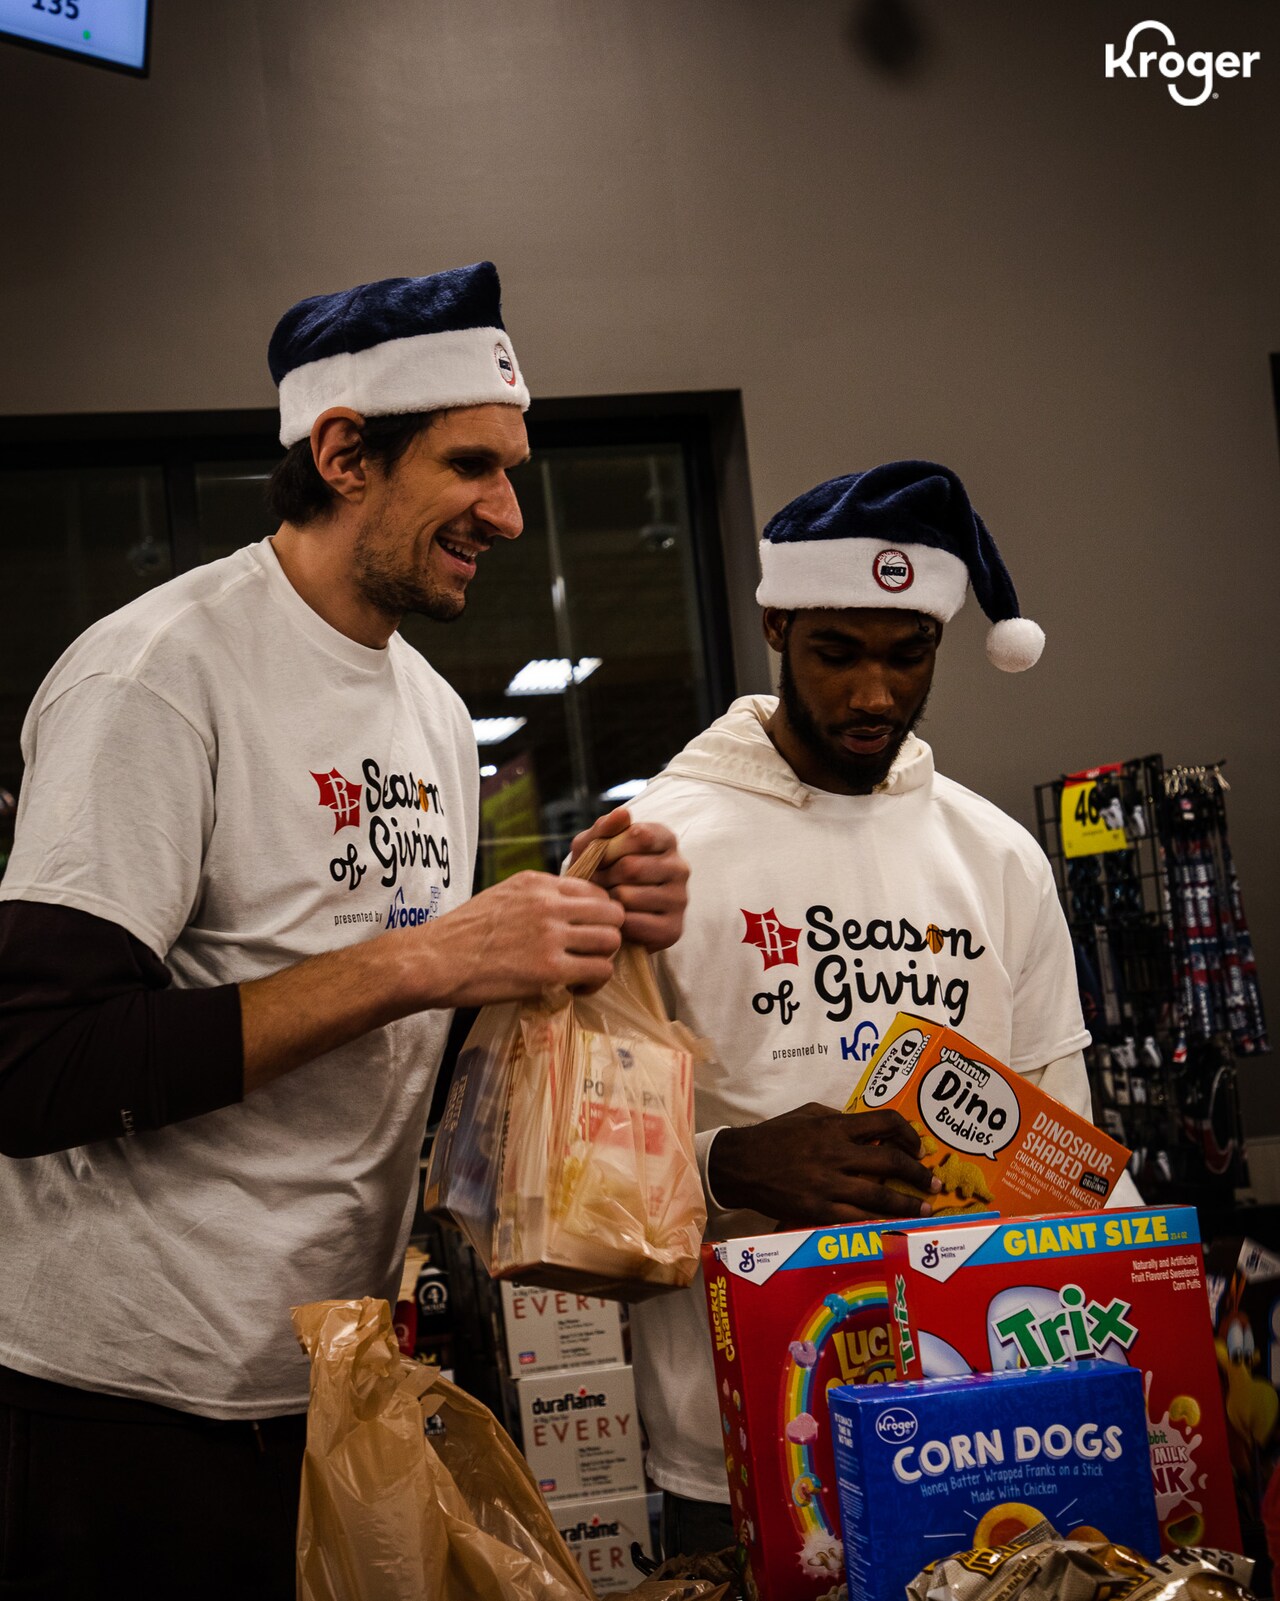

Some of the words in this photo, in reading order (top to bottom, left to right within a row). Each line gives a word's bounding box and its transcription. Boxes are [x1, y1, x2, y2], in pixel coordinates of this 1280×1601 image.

[329, 843, 367, 890] of
[369, 815, 450, 888] Giving
[334, 911, 373, 926] presented
[374, 911, 382, 924] by
[752, 980, 800, 1025] of
[814, 954, 969, 1027] Giving
[772, 1045, 815, 1060] presented
[817, 1043, 829, 1056] by
[874, 1039, 917, 1097] Dino
[940, 1047, 989, 1087] yummy
[932, 1070, 1007, 1130] Dino
[936, 1107, 993, 1145] Buddies
[1022, 1132, 1082, 1180] SHAPED
[1032, 1112, 1115, 1175] DINOSAUR-
[1006, 1170, 1018, 1182] with
[1018, 1177, 1027, 1185] rib
[1026, 1183, 1040, 1195] meat
[1010, 1161, 1031, 1179] Chicken
[1031, 1172, 1050, 1191] Breast
[1049, 1185, 1063, 1201] Patty
[1015, 1150, 1045, 1175] CHICKEN
[1045, 1169, 1070, 1189] BREAST
[1070, 1185, 1101, 1209] NUGGETS
[1082, 1178, 1107, 1194] ORIGINAL
[817, 1231, 885, 1261] GIAN
[940, 1244, 965, 1253] General
[1003, 1222, 1097, 1257] GIANT
[1104, 1216, 1169, 1247] SIZE
[756, 1250, 779, 1258] General
[940, 1251, 956, 1259] Mills
[1132, 1258, 1158, 1270] Naturally
[1159, 1257, 1169, 1268] and
[1170, 1254, 1197, 1266] Artificially
[1131, 1272, 1145, 1283] Fruit
[1145, 1270, 1169, 1281] Flavored
[1170, 1267, 1199, 1279] Sweetened
[1172, 1280, 1186, 1291] Corn
[1186, 1279, 1201, 1289] Puffs
[894, 1274, 916, 1375] Trix
[992, 1284, 1138, 1366] Trix
[532, 1394, 606, 1415] duraflame
[534, 1413, 630, 1447] EVERY
[879, 1415, 915, 1437] Kroger
[893, 1429, 1004, 1483] CORN
[1013, 1423, 1123, 1462] DOGS
[1154, 1445, 1188, 1466] MILK
[920, 1483, 948, 1497] Honey
[950, 1474, 980, 1490] Batter
[984, 1466, 1023, 1484] Wrapped
[1026, 1464, 1056, 1477] Franks
[1059, 1466, 1070, 1476] on
[1073, 1466, 1079, 1475] a
[1082, 1463, 1103, 1476] Stick
[970, 1489, 995, 1504] Made
[999, 1484, 1021, 1499] With
[1023, 1483, 1057, 1496] Chicken
